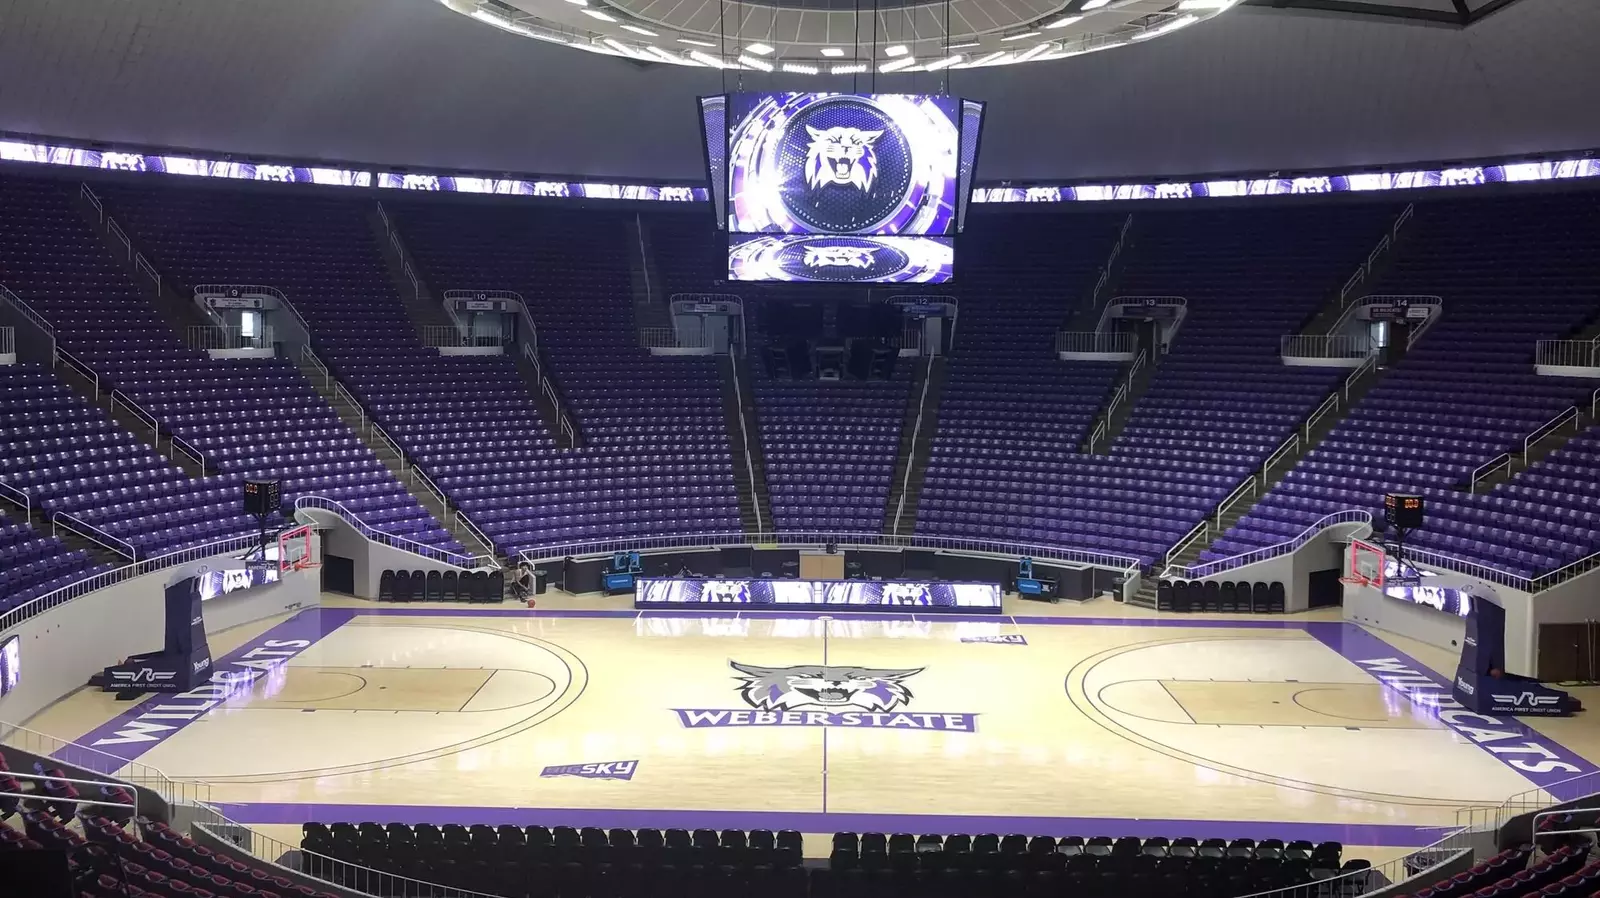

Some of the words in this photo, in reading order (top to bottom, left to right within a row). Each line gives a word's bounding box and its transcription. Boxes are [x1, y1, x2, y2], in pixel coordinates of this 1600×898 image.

[231, 289, 238, 297] 9
[91, 639, 310, 746] WILDCATS
[1458, 676, 1474, 695] Young
[683, 710, 837, 727] WEBER
[841, 711, 968, 731] STATE
[1356, 657, 1582, 773] WILDCATS
[580, 761, 635, 774] SKY
